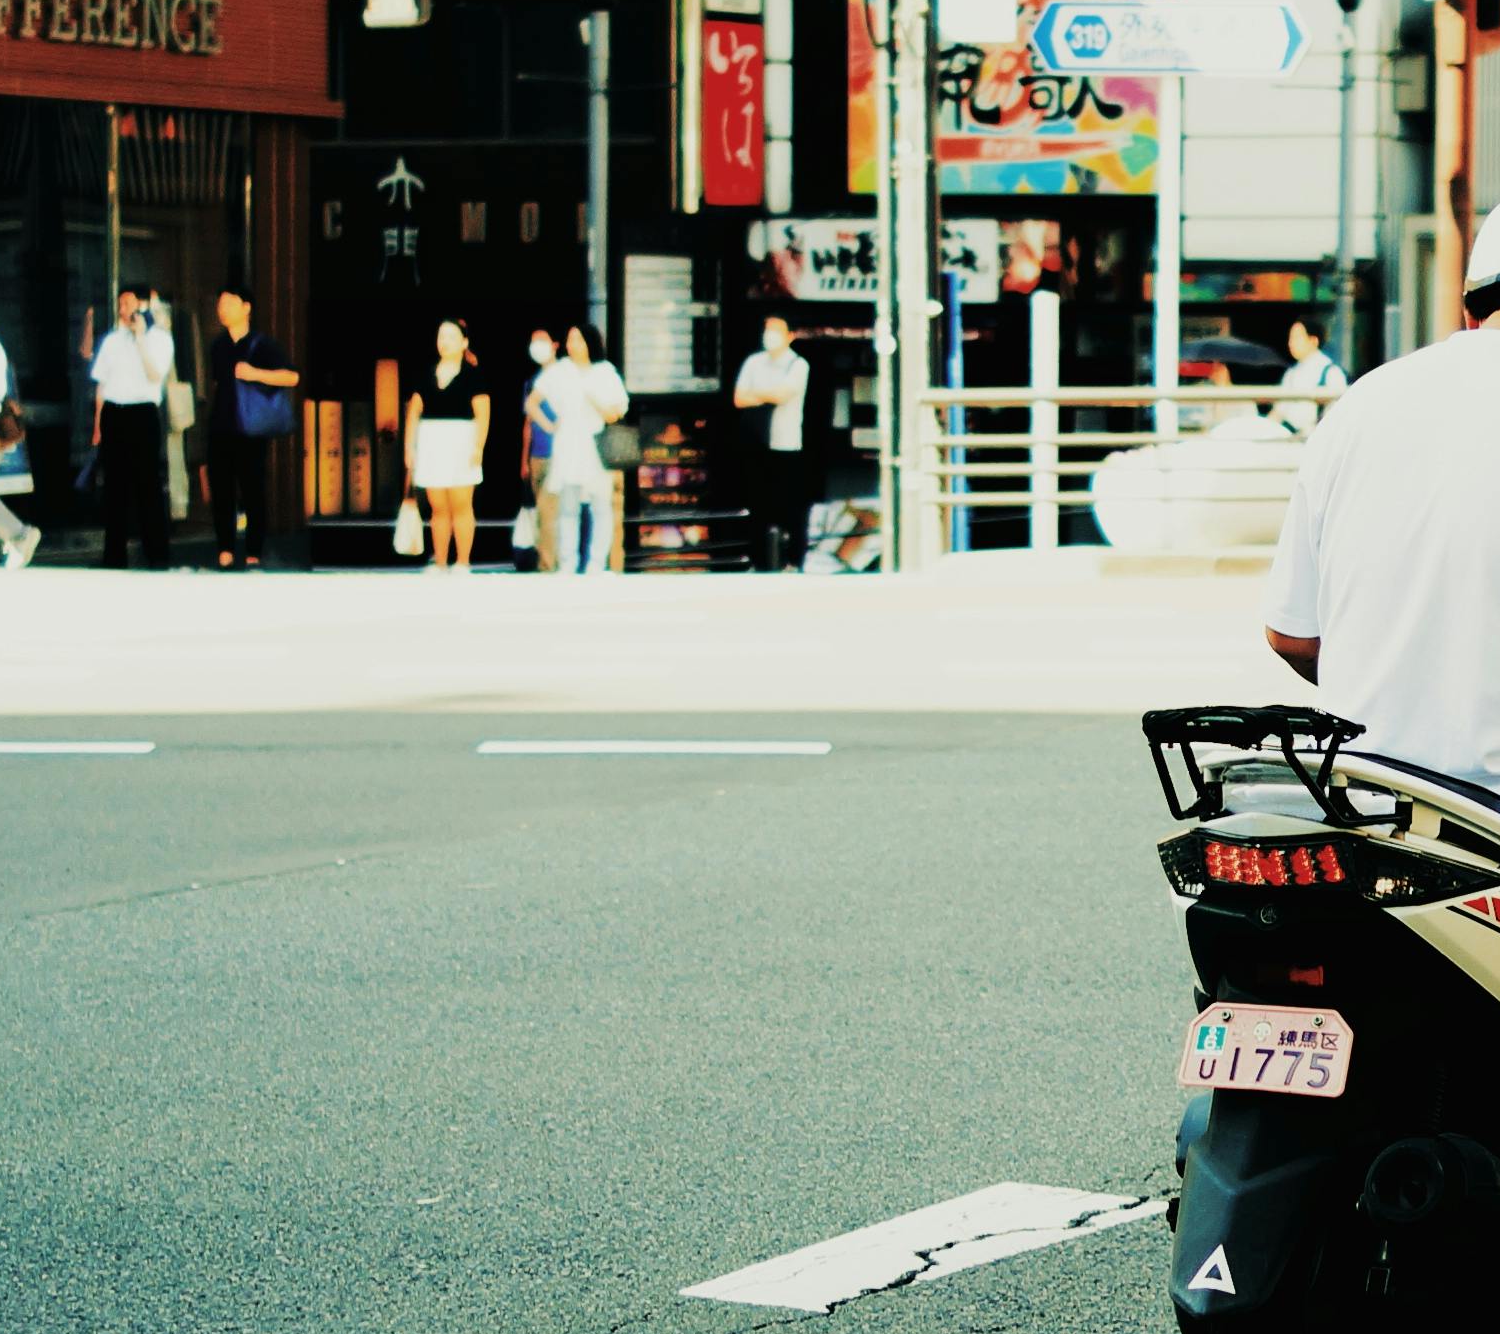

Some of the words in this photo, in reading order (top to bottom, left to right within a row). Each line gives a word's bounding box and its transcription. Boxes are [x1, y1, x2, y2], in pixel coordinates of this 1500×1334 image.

[706, 29, 757, 170] いろは
[1277, 1030, 1339, 1051] 練馬区
[1228, 1046, 1334, 1089] 1775
